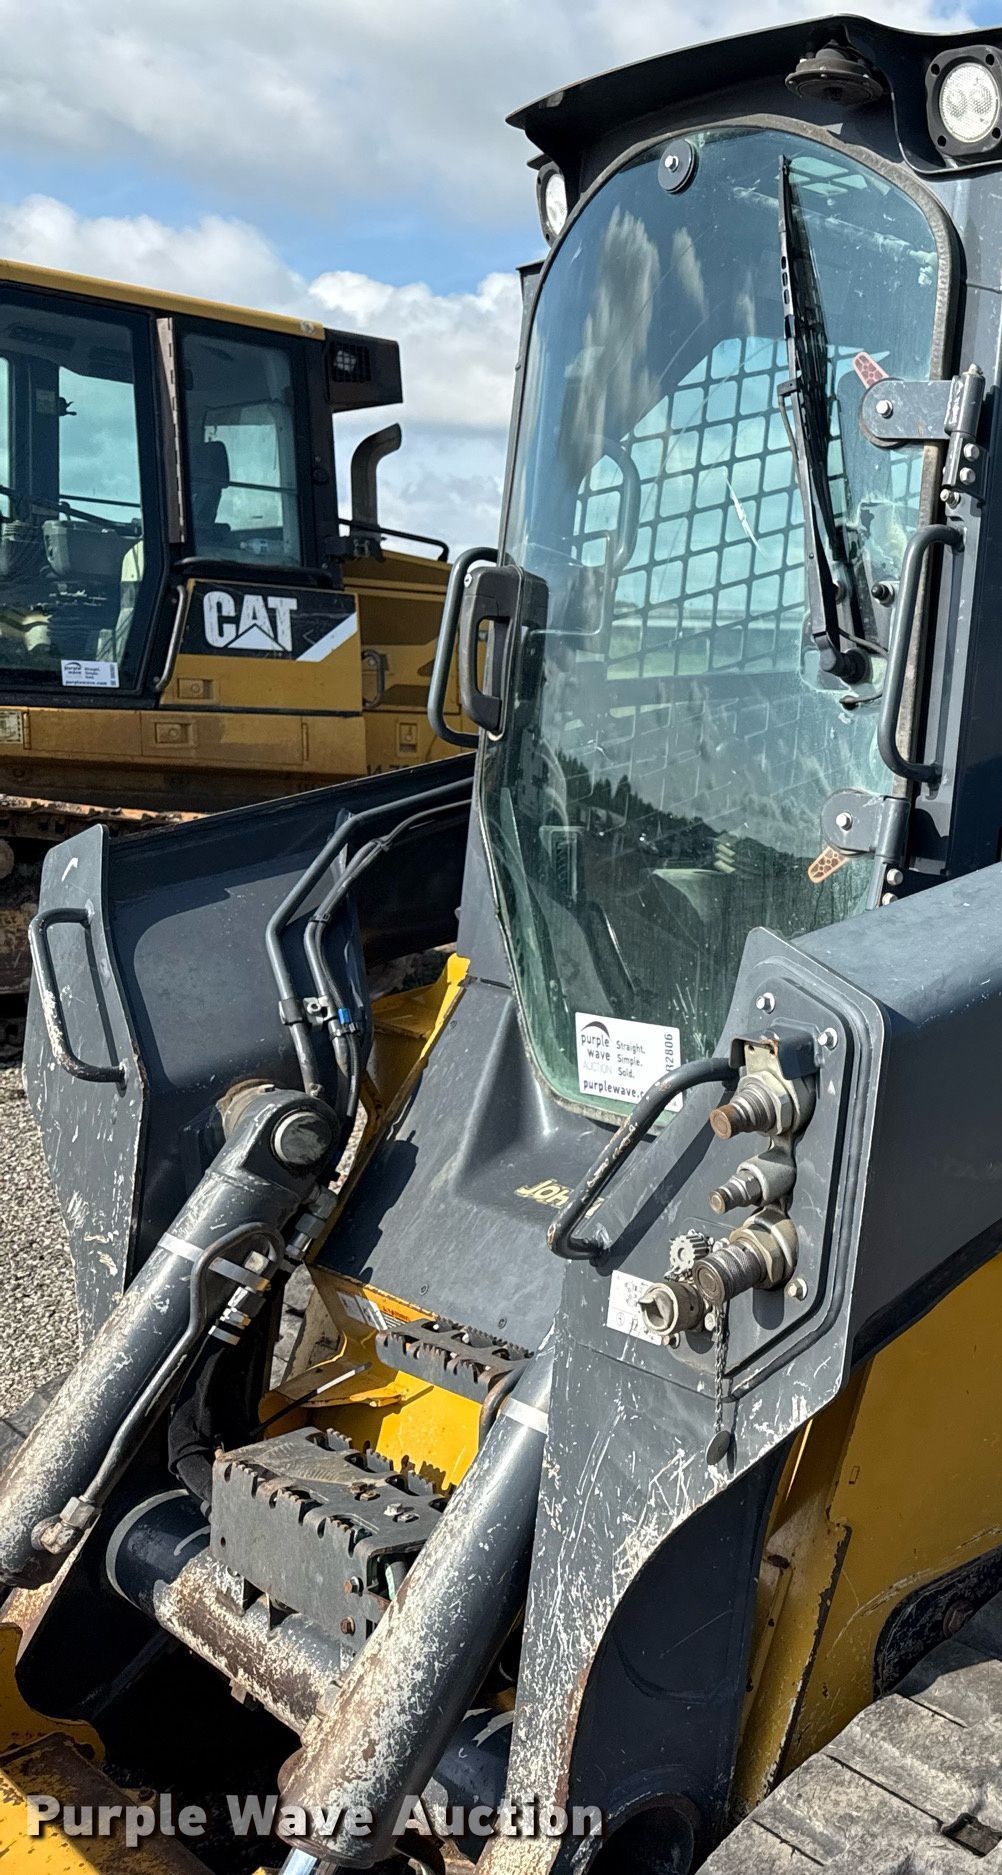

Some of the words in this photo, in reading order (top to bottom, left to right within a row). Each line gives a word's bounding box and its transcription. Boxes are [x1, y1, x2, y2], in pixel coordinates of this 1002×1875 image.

[203, 591, 297, 652] CAT
[581, 1033, 610, 1048] purple
[616, 1040, 646, 1054] Straight.
[587, 1048, 611, 1061] wave
[617, 1053, 643, 1067] Simple.
[618, 1066, 636, 1079] Sold.
